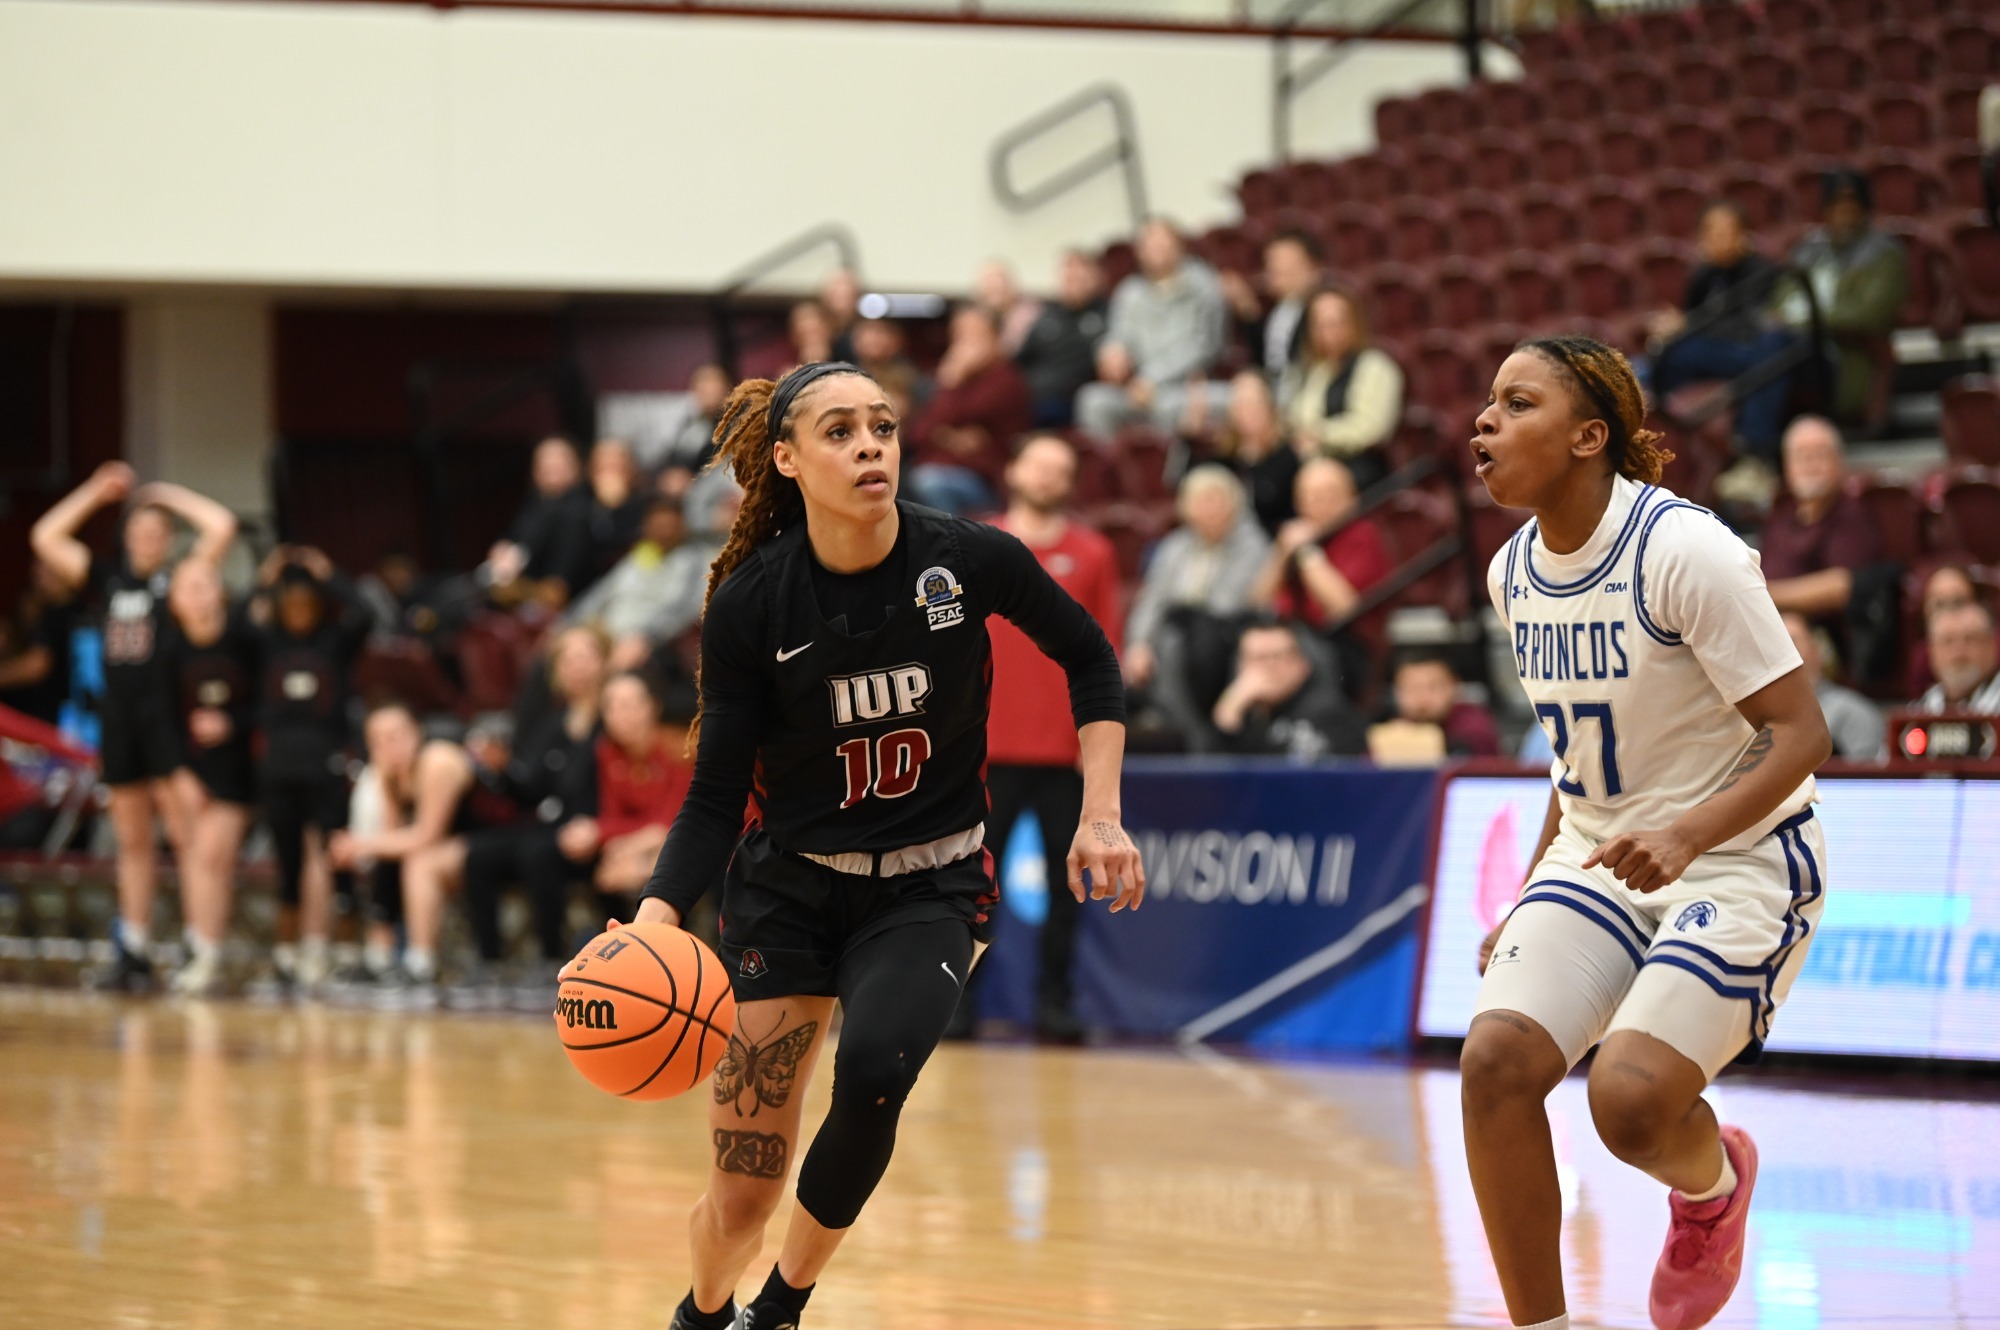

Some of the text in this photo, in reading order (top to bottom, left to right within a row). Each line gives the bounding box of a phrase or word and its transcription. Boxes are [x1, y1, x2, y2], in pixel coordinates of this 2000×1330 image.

[926, 579, 947, 596] 50
[927, 605, 964, 626] PSAC
[1604, 581, 1628, 593] CIAA
[1515, 621, 1629, 681] BRONCOS
[830, 665, 930, 724] IUP
[836, 728, 931, 809] 10
[1533, 700, 1626, 799] 27
[1138, 829, 1315, 904] VISION
[556, 996, 618, 1030] Wilso
